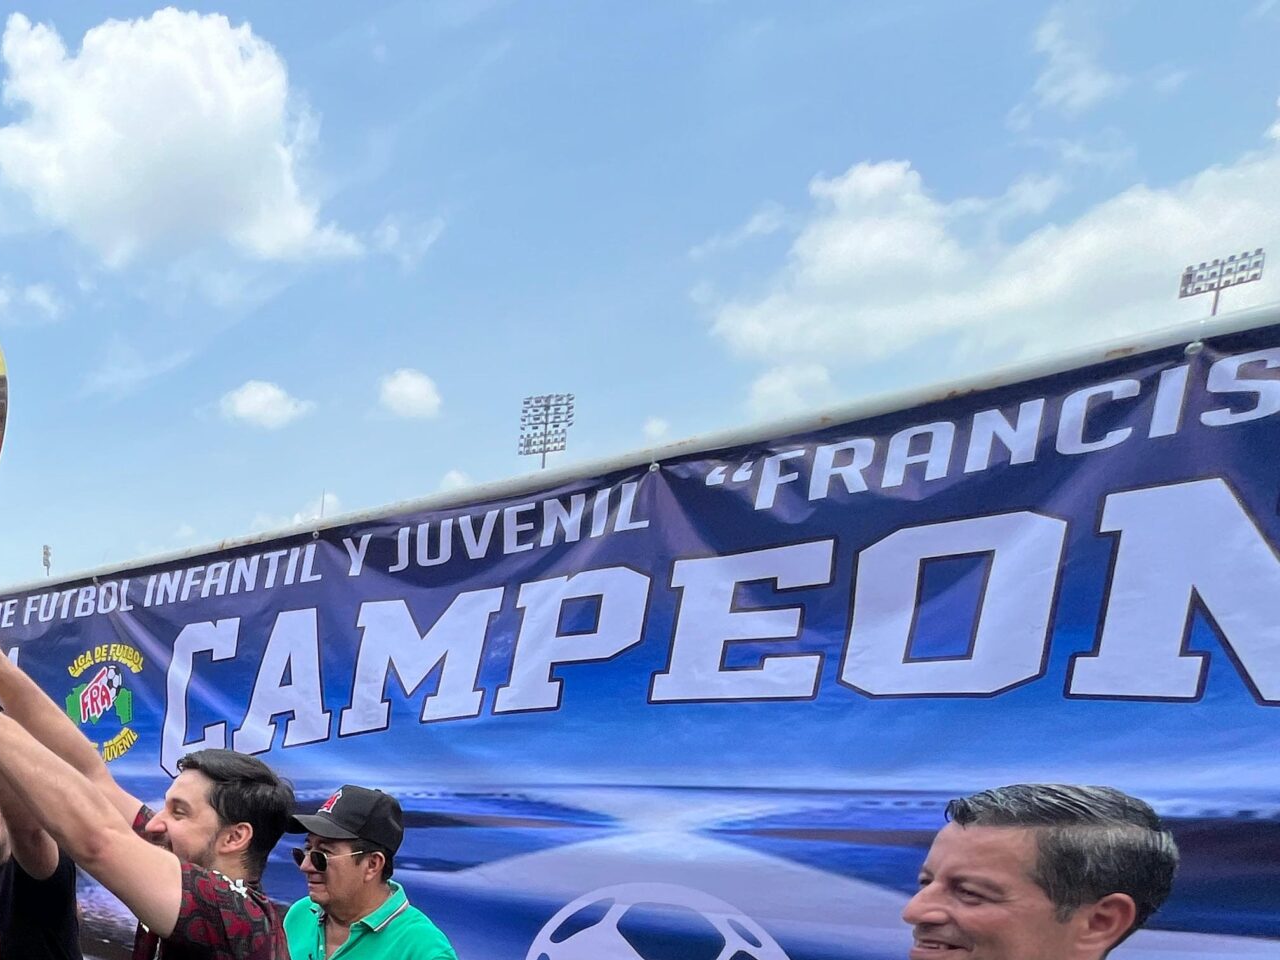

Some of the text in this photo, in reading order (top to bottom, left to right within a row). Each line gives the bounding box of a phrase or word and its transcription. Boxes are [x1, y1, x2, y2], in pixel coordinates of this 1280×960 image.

[23, 579, 134, 626] FUTBOL
[144, 544, 322, 607] INFANTIL
[343, 537, 373, 577] Y
[388, 482, 650, 574] JUVENIL
[161, 477, 1280, 779] CAMPEON
[68, 643, 144, 678] LIGA DE FUTBOL
[80, 666, 113, 723] FRA
[102, 727, 138, 763] JUVENIL
